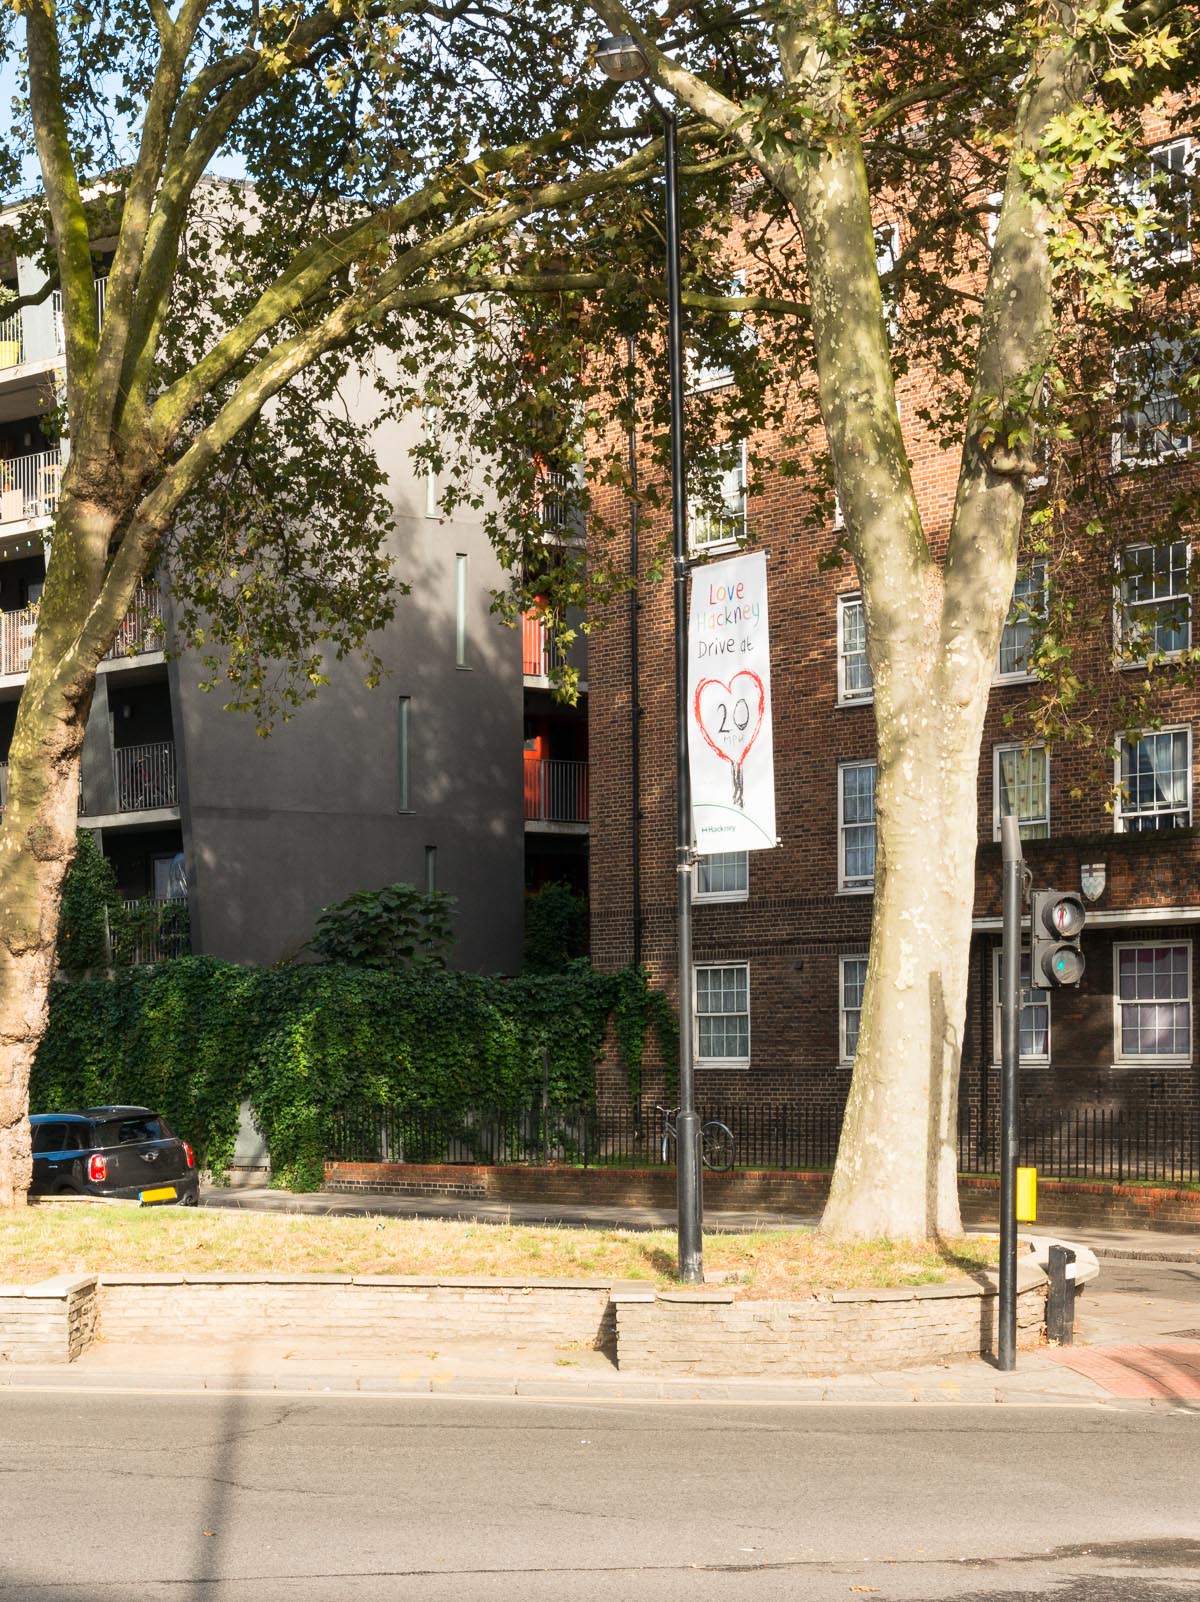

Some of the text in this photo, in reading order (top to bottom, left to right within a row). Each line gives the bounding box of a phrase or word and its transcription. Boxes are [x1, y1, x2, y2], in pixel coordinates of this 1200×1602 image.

[709, 582, 744, 605] Love
[697, 602, 760, 632] Hackney
[697, 635, 754, 658] Drive at
[717, 698, 750, 733] 20
[708, 824, 736, 833] Hackney
